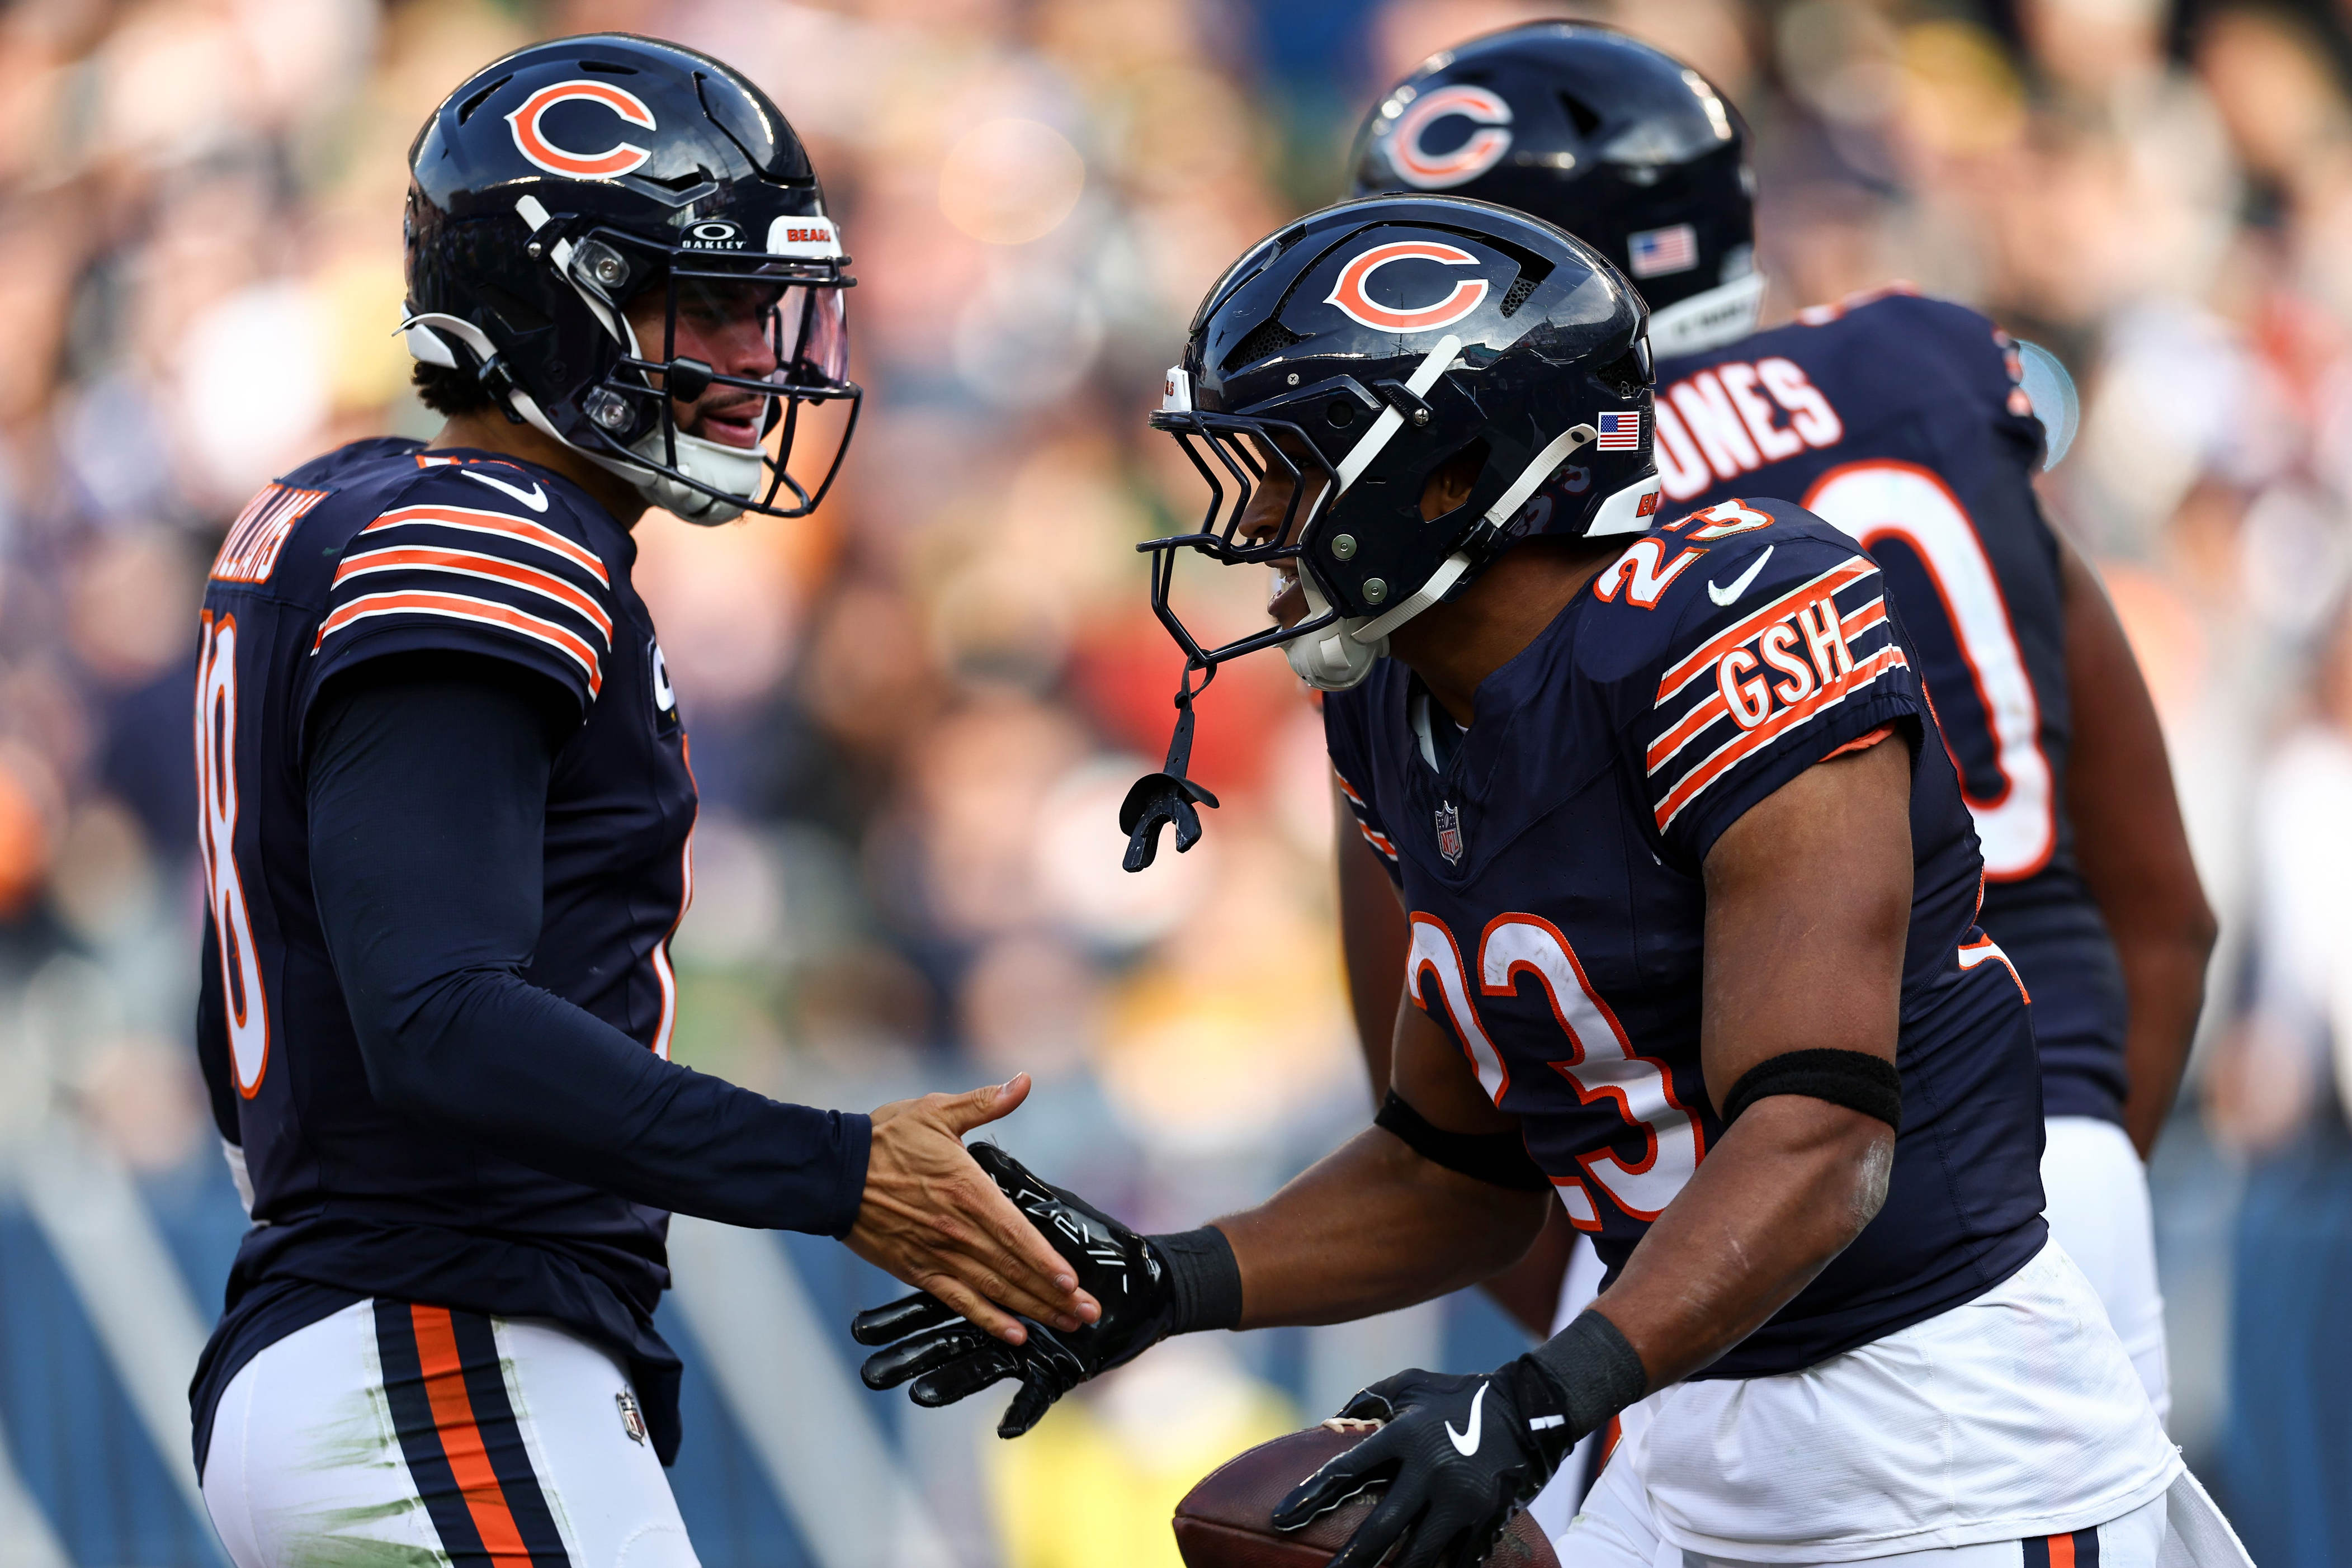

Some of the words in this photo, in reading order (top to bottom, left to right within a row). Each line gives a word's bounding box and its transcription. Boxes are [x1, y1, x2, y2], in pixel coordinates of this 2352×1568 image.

[503, 79, 657, 180] C
[1385, 84, 1513, 190] C
[682, 240, 744, 249] OAKLEY
[1323, 240, 1489, 334] C
[1654, 356, 1844, 510] ONES
[1593, 498, 1775, 611] 23
[1716, 593, 1855, 731] GSH
[1406, 911, 1706, 1232] 23
